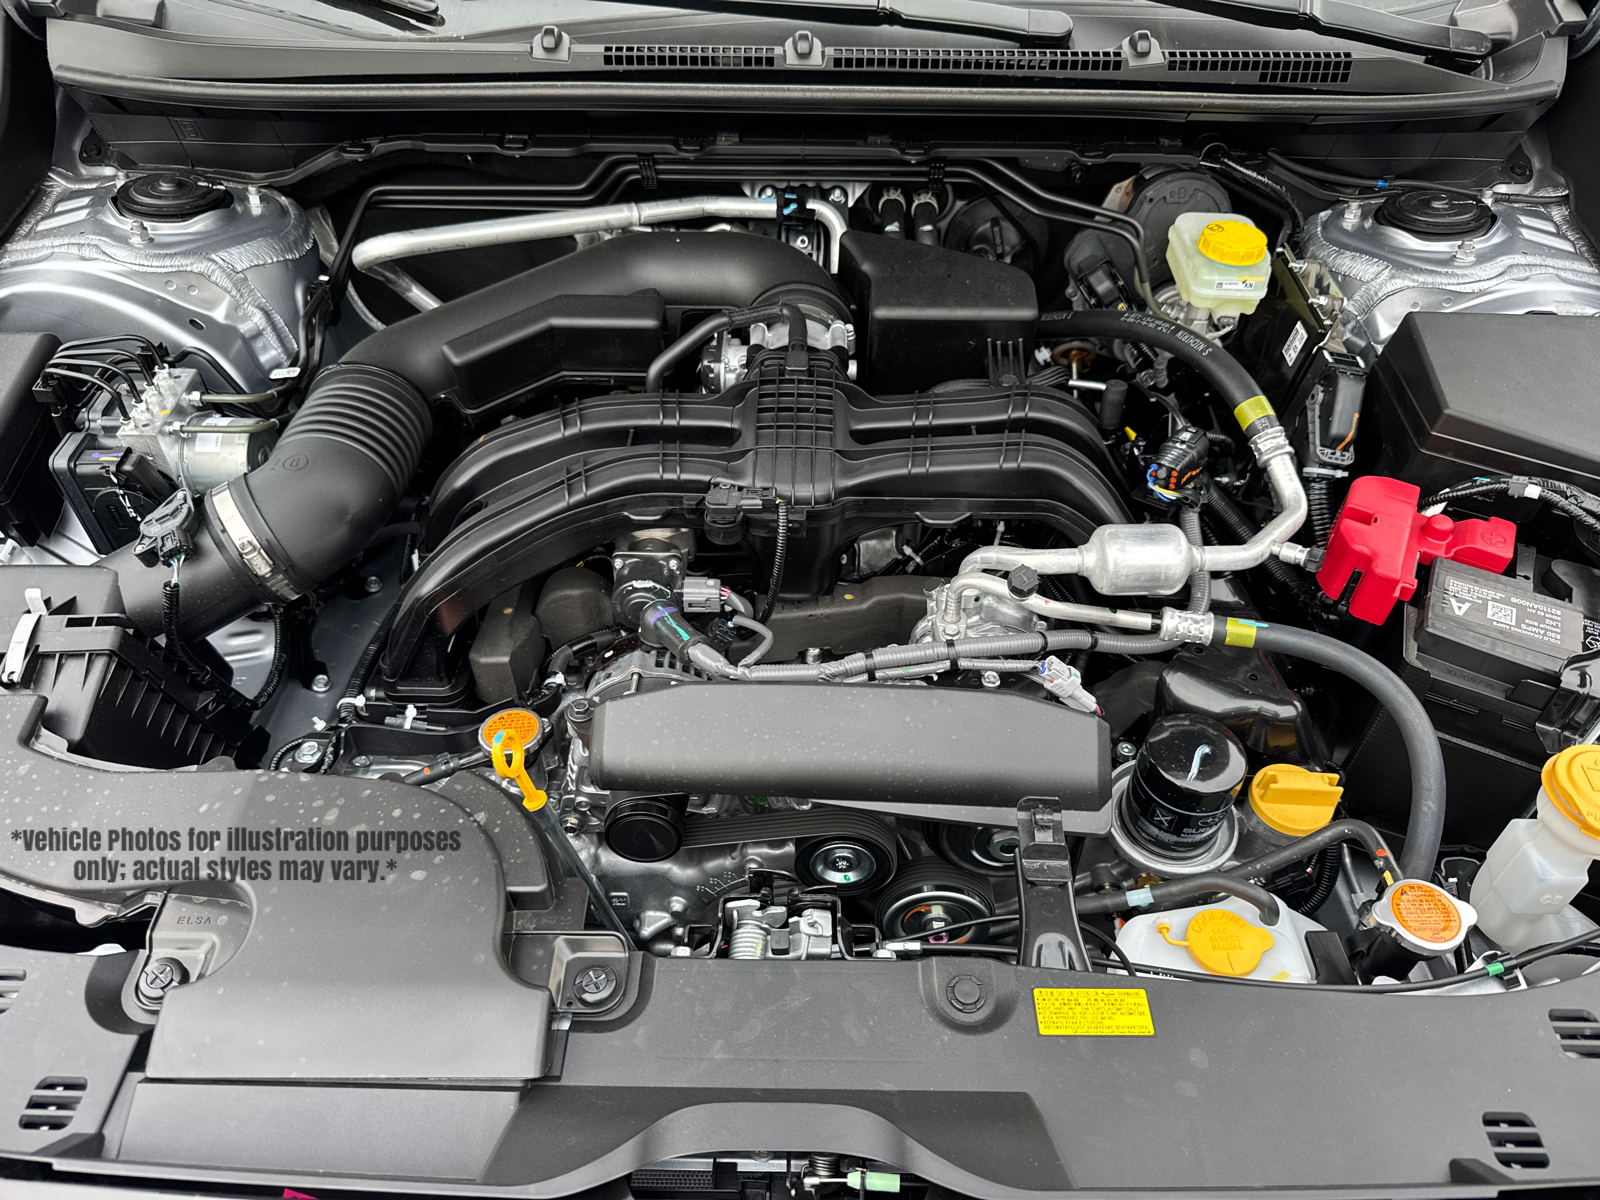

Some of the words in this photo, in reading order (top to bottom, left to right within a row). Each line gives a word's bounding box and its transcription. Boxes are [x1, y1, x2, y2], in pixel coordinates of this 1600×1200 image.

[1449, 598, 1471, 616] A
[1510, 597, 1561, 615] 82110AN00B
[1492, 621, 1510, 629] AMPS
[1540, 623, 1561, 633] GROUP
[1544, 619, 1561, 628] LN2
[1511, 626, 1543, 640] CRANKING
[1521, 624, 1545, 635] AMPS
[1543, 636, 1561, 645] COLD
[177, 916, 211, 925] ELSA
[1191, 911, 1250, 933] COOLANT
[1209, 935, 1242, 944] OWNERS
[1211, 943, 1244, 951] MANUAL
